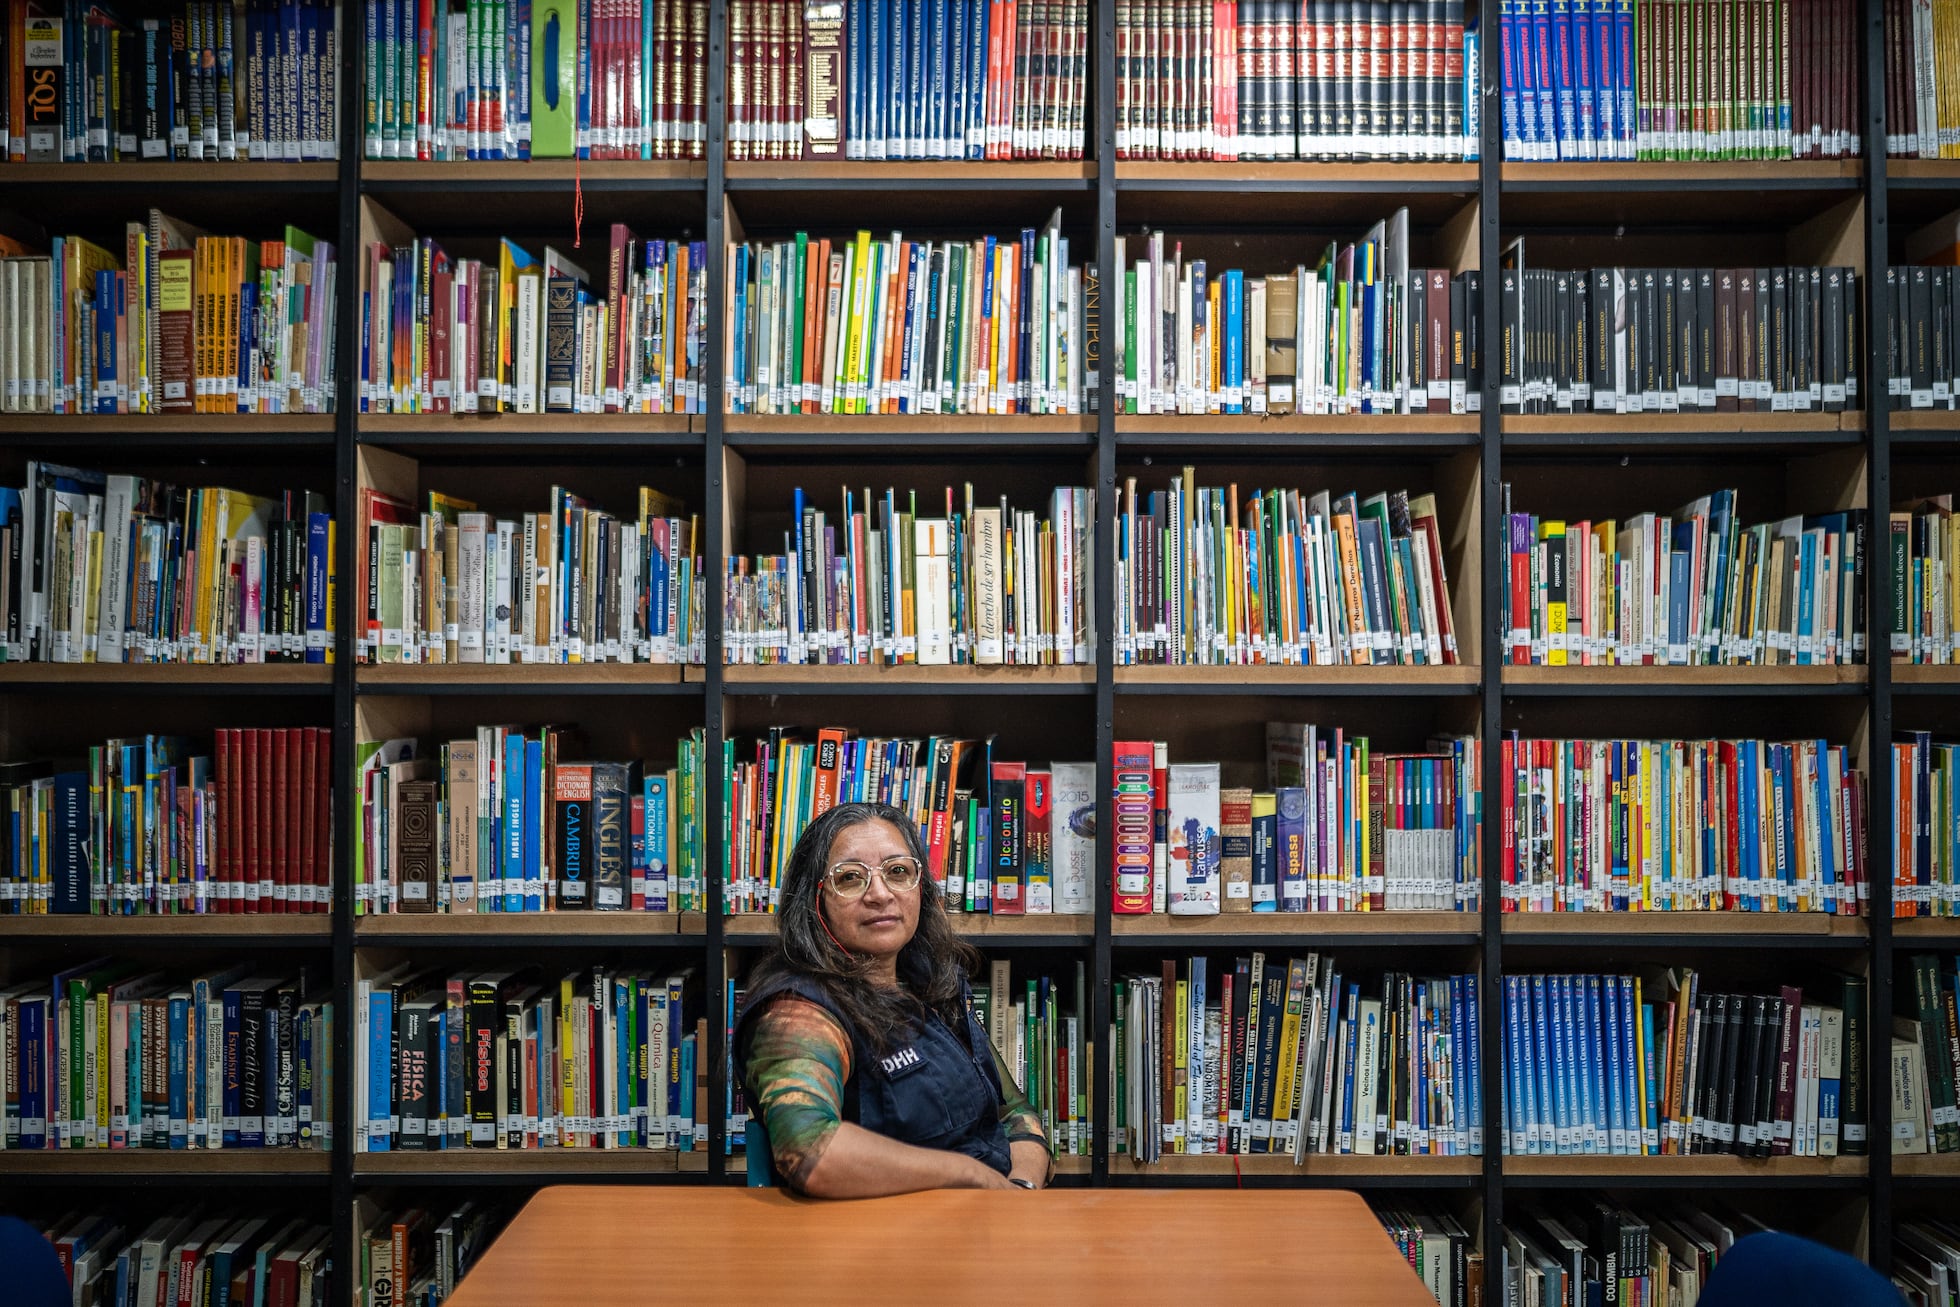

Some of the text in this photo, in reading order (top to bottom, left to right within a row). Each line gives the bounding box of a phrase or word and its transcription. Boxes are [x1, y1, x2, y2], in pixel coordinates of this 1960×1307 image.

[172, 18, 185, 53] COBOL
[146, 65, 157, 84] 2000
[1470, 49, 1480, 78] TODO
[27, 68, 56, 121] SQL
[129, 234, 138, 304] TU HIJO CRECE
[949, 284, 957, 317] SOCIEDAD
[218, 295, 226, 375] CAJITA SORPRESAS
[229, 294, 238, 375] CAJITA SORPRESAS
[850, 335, 858, 361] MAESTRO
[670, 522, 678, 547] COLOMBIA
[463, 548, 471, 600] Constitucional
[670, 555, 678, 571] PODER
[1554, 552, 1562, 587] Economía
[1895, 544, 1903, 572] derecho
[311, 555, 319, 623] ESTADO MUNDO
[524, 560, 533, 602] EXTERIOR
[572, 567, 580, 587] TODO
[979, 518, 994, 634] derecho de ser hombre
[1346, 550, 1361, 621] Nuestros Derechos
[1896, 582, 1904, 631] Introducción
[821, 743, 831, 766] CURSO
[557, 781, 591, 789] DICTIONARY
[563, 790, 591, 798] ENGLISH
[1059, 791, 1090, 802] 2015
[510, 798, 520, 858] HABLE INGLÉS
[600, 797, 623, 884] INGLÉS
[647, 799, 656, 852] DICTIONARY
[933, 815, 943, 845] Français
[999, 799, 1012, 866] Diccionario
[68, 833, 80, 902] RELATOS PACÍFICOS
[1194, 827, 1206, 878] Larousse
[1653, 896, 1660, 908] 9
[1509, 979, 1515, 987] 4
[1520, 979, 1526, 987] 5
[1590, 979, 1600, 987] 10
[1607, 979, 1614, 987] 11
[1622, 979, 1632, 987] 12
[1717, 1000, 1723, 1008] 2
[1735, 1001, 1742, 1009] 3
[1758, 1001, 1765, 1009] 4
[1773, 1001, 1780, 1009] 5
[1190, 981, 1204, 1101] Colombia land of Flowers
[1248, 1030, 1256, 1046] VIVOS
[1319, 1009, 1328, 1041] ANIMALES
[1679, 1017, 1687, 1043] INVENTOS
[1804, 1020, 1809, 1028] 1
[1812, 1020, 1820, 1028] 2
[1850, 1019, 1856, 1029] EN
[228, 1031, 240, 1090] ESTADÍSTICA
[279, 995, 293, 1112] Carl Sagan COSMOS
[477, 1028, 492, 1091] Física
[640, 1044, 648, 1079] QUÍMICA
[652, 1022, 665, 1069] Química
[881, 1047, 920, 1074] DHH
[1233, 1016, 1245, 1101] MUNDO ANIMAL
[1363, 1023, 1371, 1066] inesperados
[1780, 1004, 1793, 1092] Neuroanatomía funcional
[1950, 1037, 1960, 1062] Salud
[60, 1047, 68, 1083] ALGEBRA
[245, 1017, 260, 1108] Precálculo
[375, 1043, 384, 1101] CONCEPTUAL
[402, 1049, 411, 1101] GENERAL
[412, 1050, 428, 1101] FÍSICA
[565, 1059, 574, 1078] Física
[671, 1047, 679, 1083] QUÍMICA
[1259, 1016, 1276, 1115] El Mundo los Animales
[1280, 1075, 1289, 1110] ANIMALES
[1901, 1057, 1911, 1110] Diagnóstico médico
[178, 1262, 187, 1301] universitaria
[183, 1260, 193, 1302] Contabilidad
[394, 1231, 403, 1300] JUGAR APRENDER
[1606, 1252, 1617, 1301] COLOMBIA
